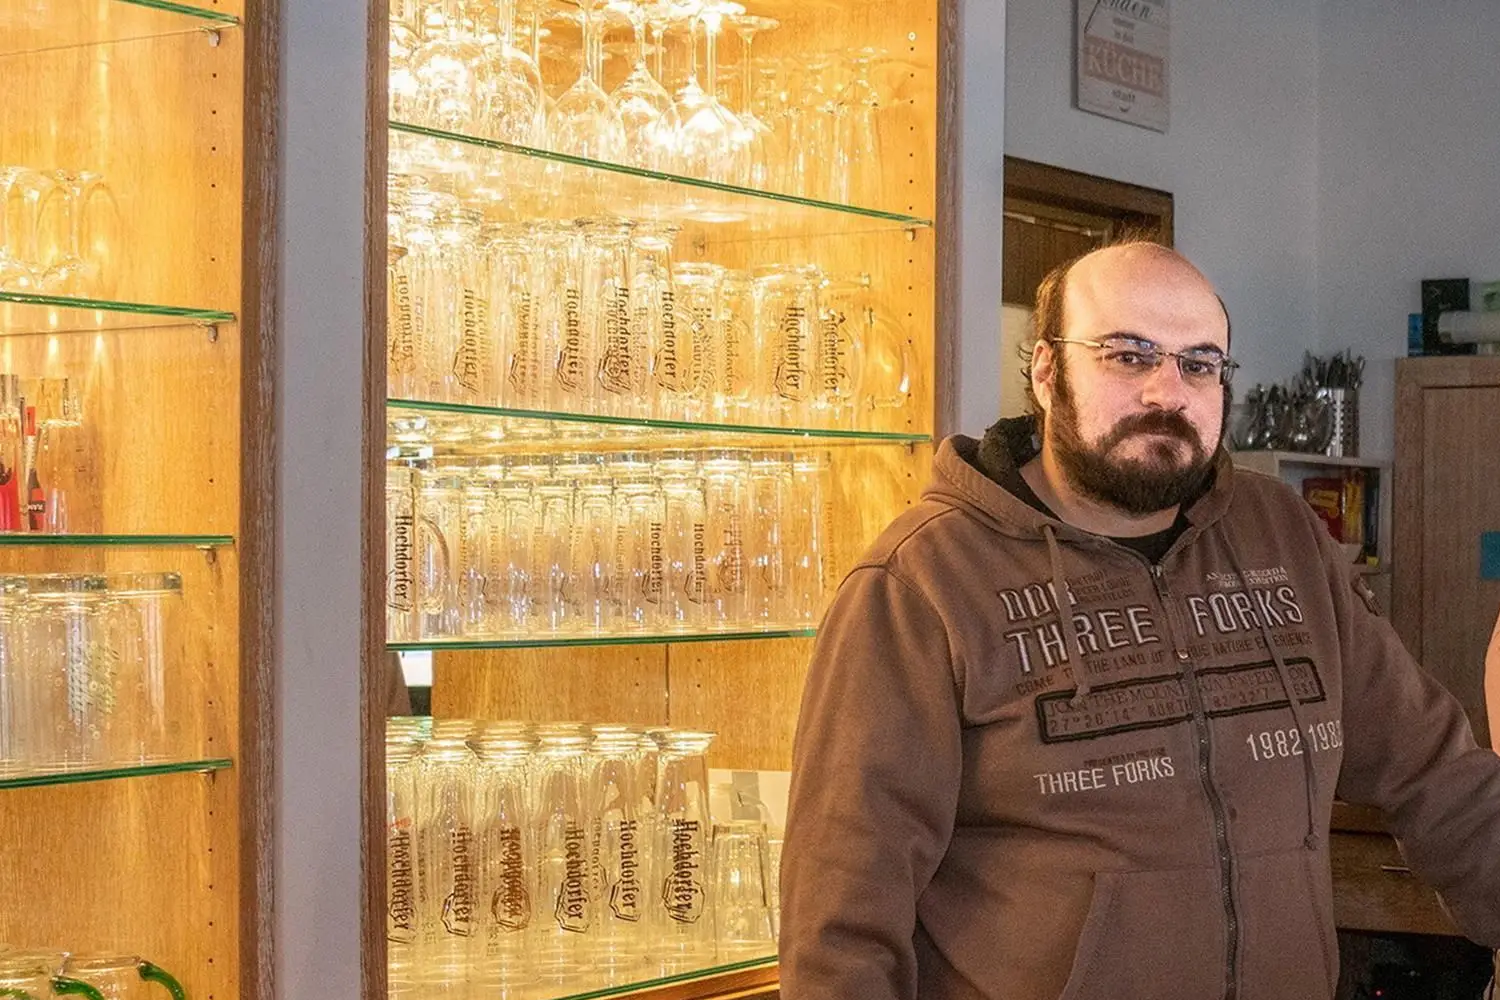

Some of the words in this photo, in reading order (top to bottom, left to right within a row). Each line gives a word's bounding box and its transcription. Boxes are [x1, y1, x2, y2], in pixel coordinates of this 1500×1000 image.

[619, 287, 632, 376] Hochdorfer
[663, 291, 677, 378] Hochdorfer
[786, 307, 806, 389] Hochdorfer
[395, 515, 413, 598] Hochdorfer
[651, 522, 663, 593] Hochdorfer
[694, 523, 706, 593] Hochdorfer
[1005, 606, 1160, 673] THREE
[1189, 586, 1303, 637] FORKS
[1085, 659, 1111, 675] THE
[1113, 653, 1147, 671] LAND
[1033, 767, 1106, 794] THREE
[1111, 756, 1175, 786] FORKS
[1246, 728, 1303, 761] 1982
[565, 829, 588, 918] Hochdorfer
[620, 820, 640, 908] Hochdorfer
[676, 820, 699, 909] Hochdorfer
